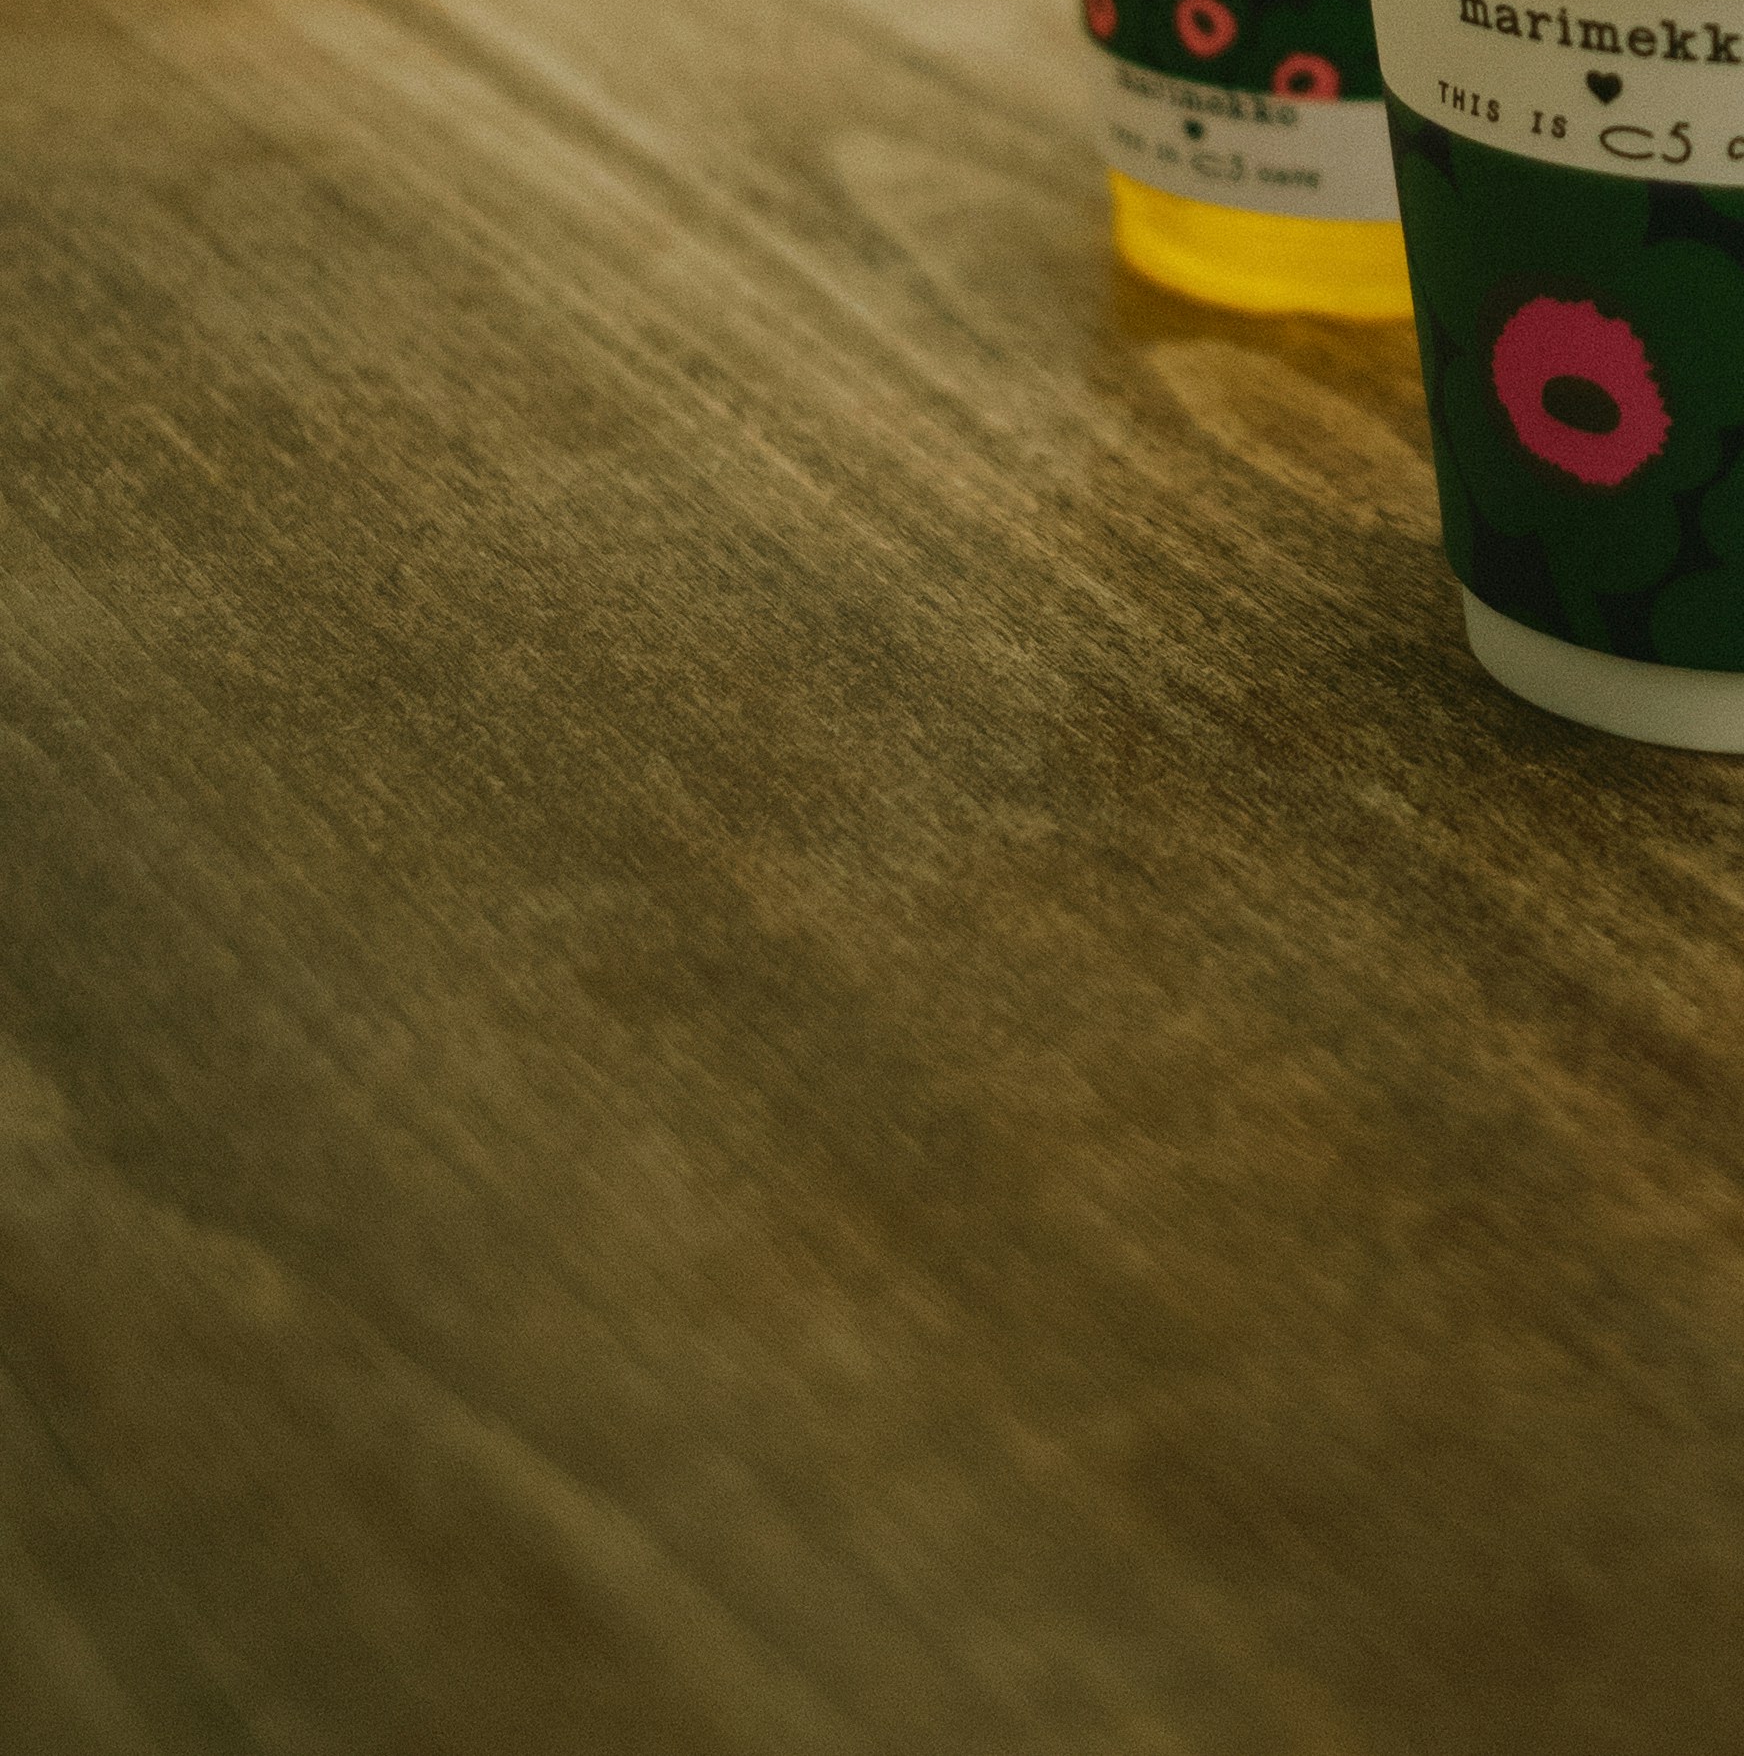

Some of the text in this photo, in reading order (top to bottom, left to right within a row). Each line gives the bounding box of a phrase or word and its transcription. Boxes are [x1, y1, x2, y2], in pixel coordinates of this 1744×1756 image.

[1437, 80, 1500, 123] THIS
[1531, 110, 1569, 140] IS
[1599, 121, 1692, 164] C5
